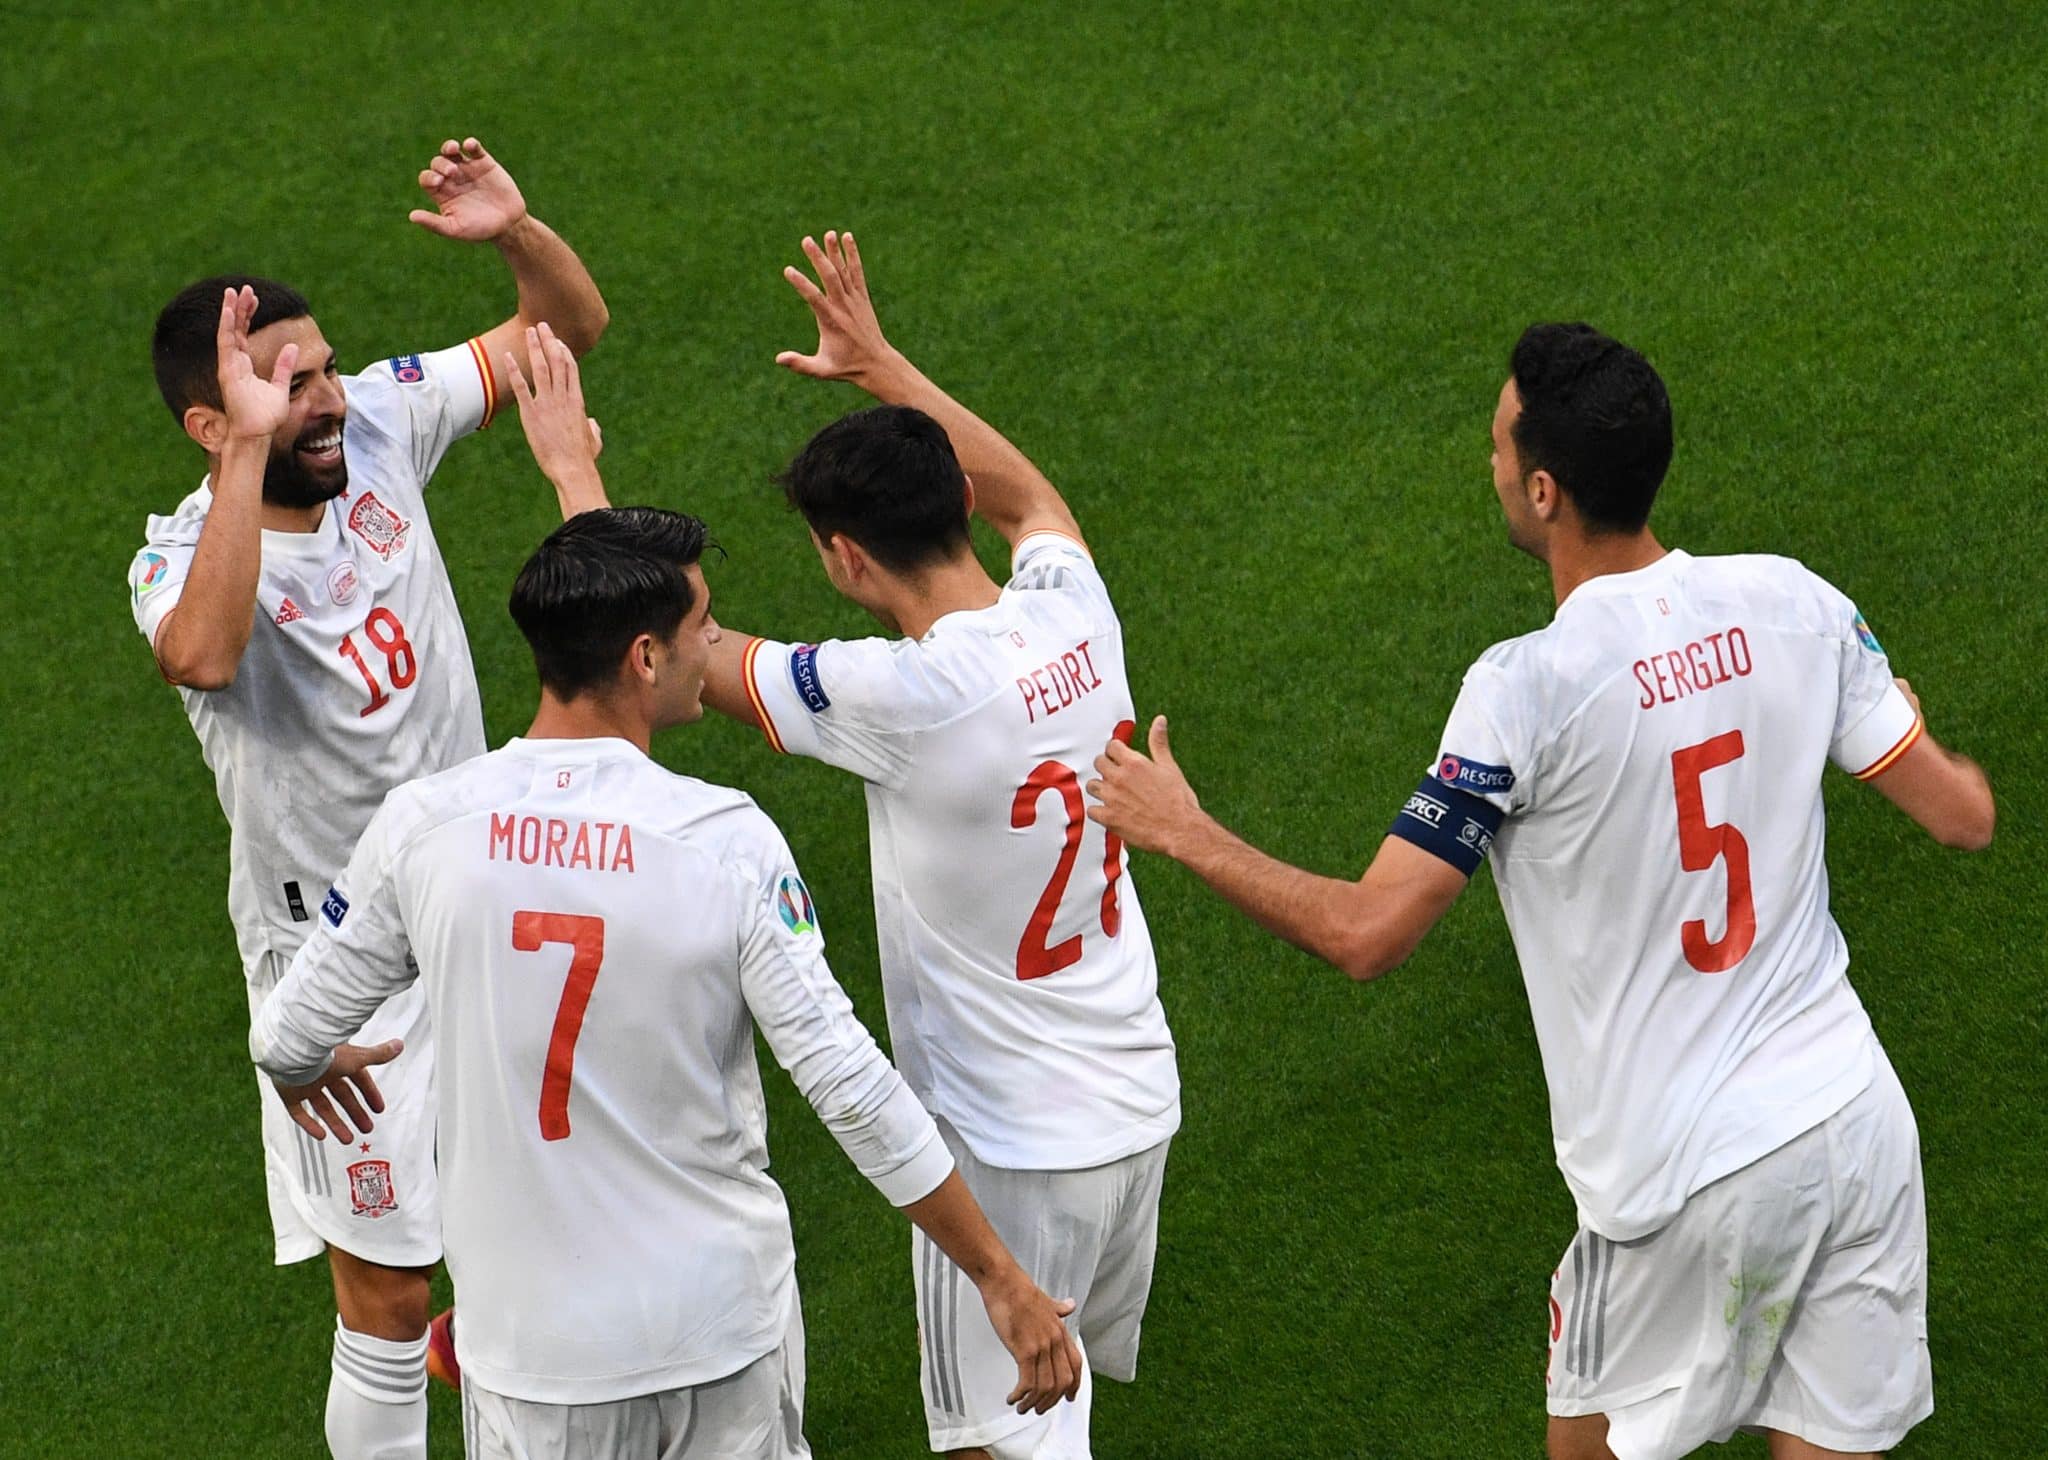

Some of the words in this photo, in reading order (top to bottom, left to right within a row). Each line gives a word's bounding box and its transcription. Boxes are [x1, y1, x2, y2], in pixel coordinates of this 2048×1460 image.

[338, 606, 416, 718] 18
[797, 652, 825, 709] RESPECT
[1016, 640, 1102, 724] PEDRI
[1633, 627, 1752, 710] SERGIO
[1459, 766, 1514, 786] RESPECT
[489, 812, 634, 873] MORATA
[1671, 728, 1756, 973] 5
[512, 910, 604, 1142] 7
